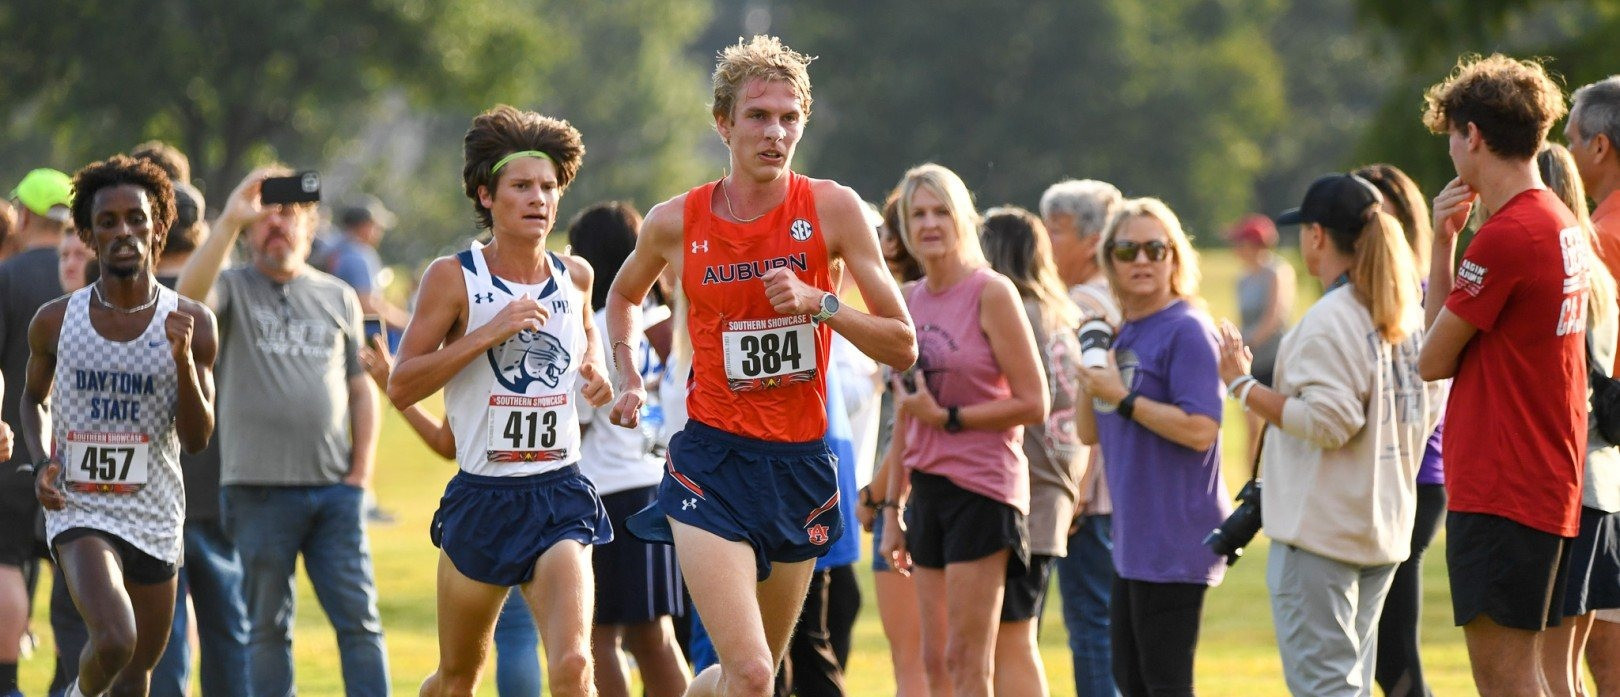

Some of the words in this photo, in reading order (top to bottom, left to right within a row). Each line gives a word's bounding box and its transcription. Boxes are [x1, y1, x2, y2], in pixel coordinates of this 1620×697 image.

[791, 220, 813, 241] SEC
[729, 319, 767, 331] SOUTHERN
[767, 314, 807, 330] SHOWCASE
[740, 331, 802, 377] 384
[76, 369, 155, 395] DAYTONA
[90, 397, 141, 421] STATE
[496, 396, 532, 406] SOUTHERN
[532, 393, 564, 407] SHOWCASE
[73, 432, 107, 443] SOUTHERN
[107, 434, 143, 444] SHOWCASE
[503, 410, 558, 449] 413
[80, 446, 135, 481] 457
